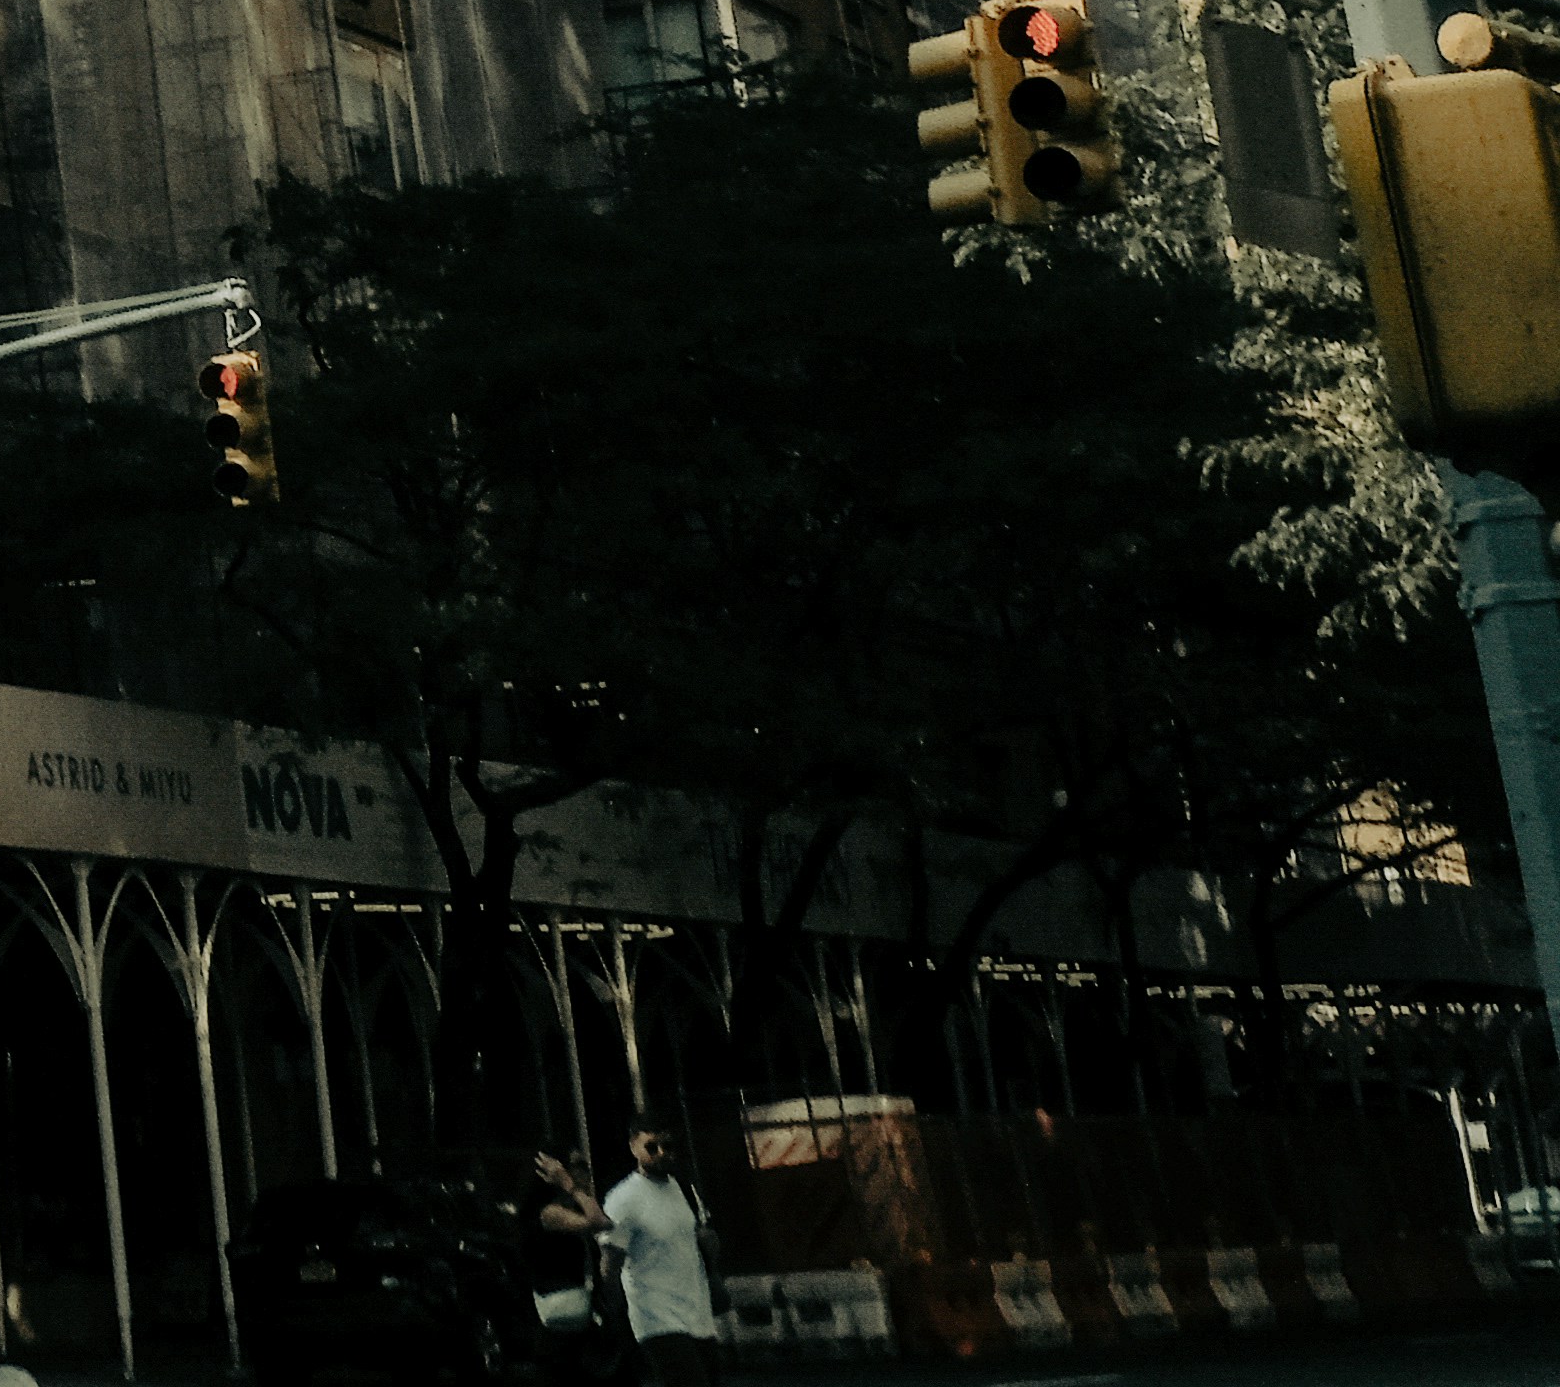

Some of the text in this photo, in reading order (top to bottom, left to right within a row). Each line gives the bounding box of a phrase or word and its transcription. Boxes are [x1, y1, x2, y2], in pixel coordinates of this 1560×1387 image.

[27, 751, 193, 804] ASTRID & MIYU
